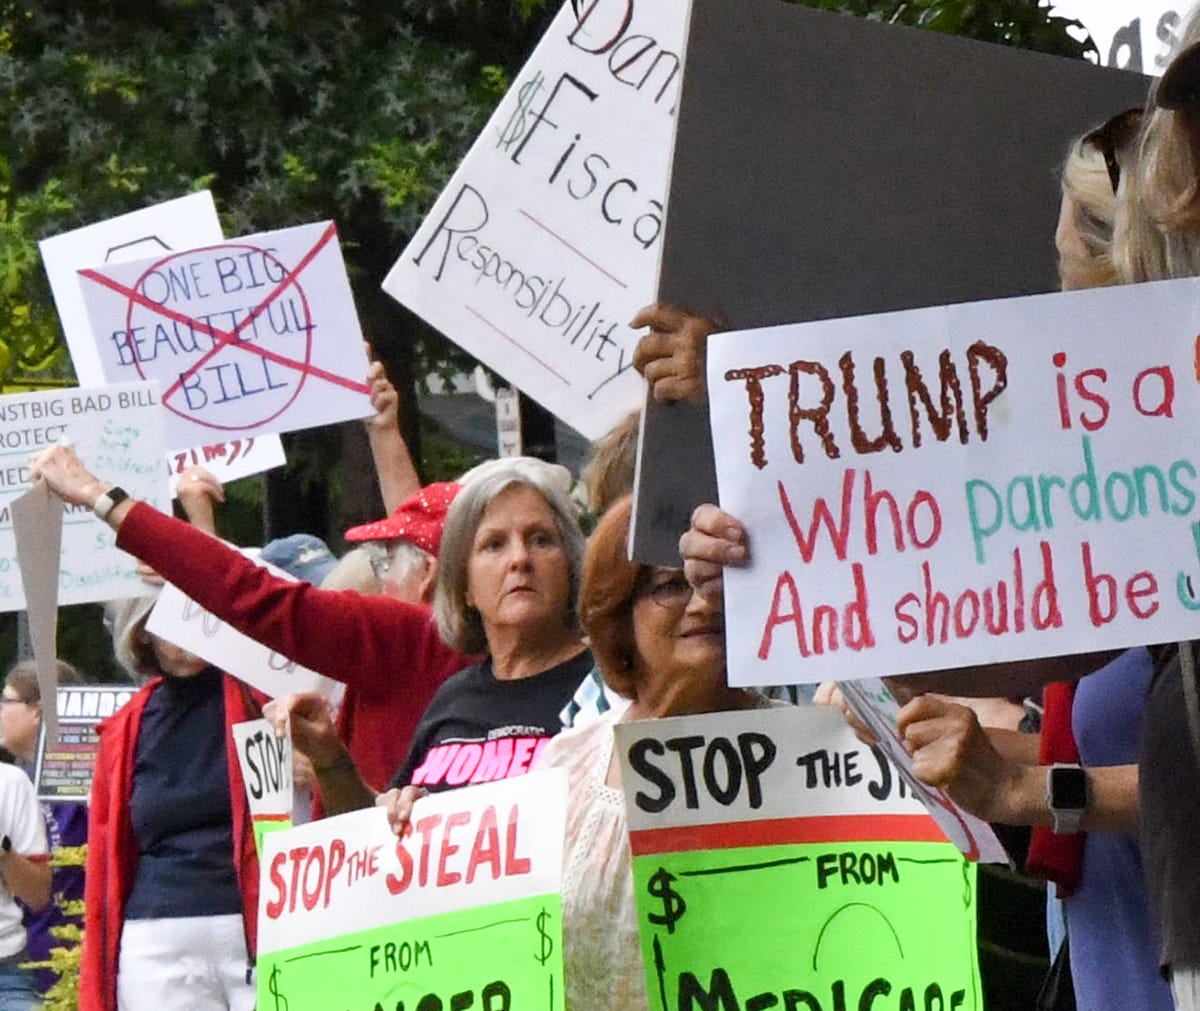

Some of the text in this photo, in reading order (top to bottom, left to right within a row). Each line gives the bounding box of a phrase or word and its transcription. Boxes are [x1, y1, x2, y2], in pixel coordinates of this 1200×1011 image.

[496, 71, 664, 250] $Fisca
[140, 248, 286, 306] ONE BIG
[413, 184, 634, 400] Responsibility
[111, 298, 317, 366] BEAUTIFUL
[71, 393, 112, 416] BAD
[118, 388, 157, 409] BILL
[179, 356, 288, 411] BILL
[724, 339, 1008, 471] TRUMP
[1052, 352, 1110, 432] is
[1132, 365, 1175, 419] a
[777, 434, 1198, 565] Who pardons
[757, 562, 876, 661] And
[893, 540, 1063, 647] should
[1081, 541, 1161, 628] be
[627, 731, 777, 813] STOP
[797, 750, 863, 790] THE
[265, 803, 532, 920] STOP THE STEAL
[816, 851, 900, 890] FROM
[369, 940, 434, 978] FROM
